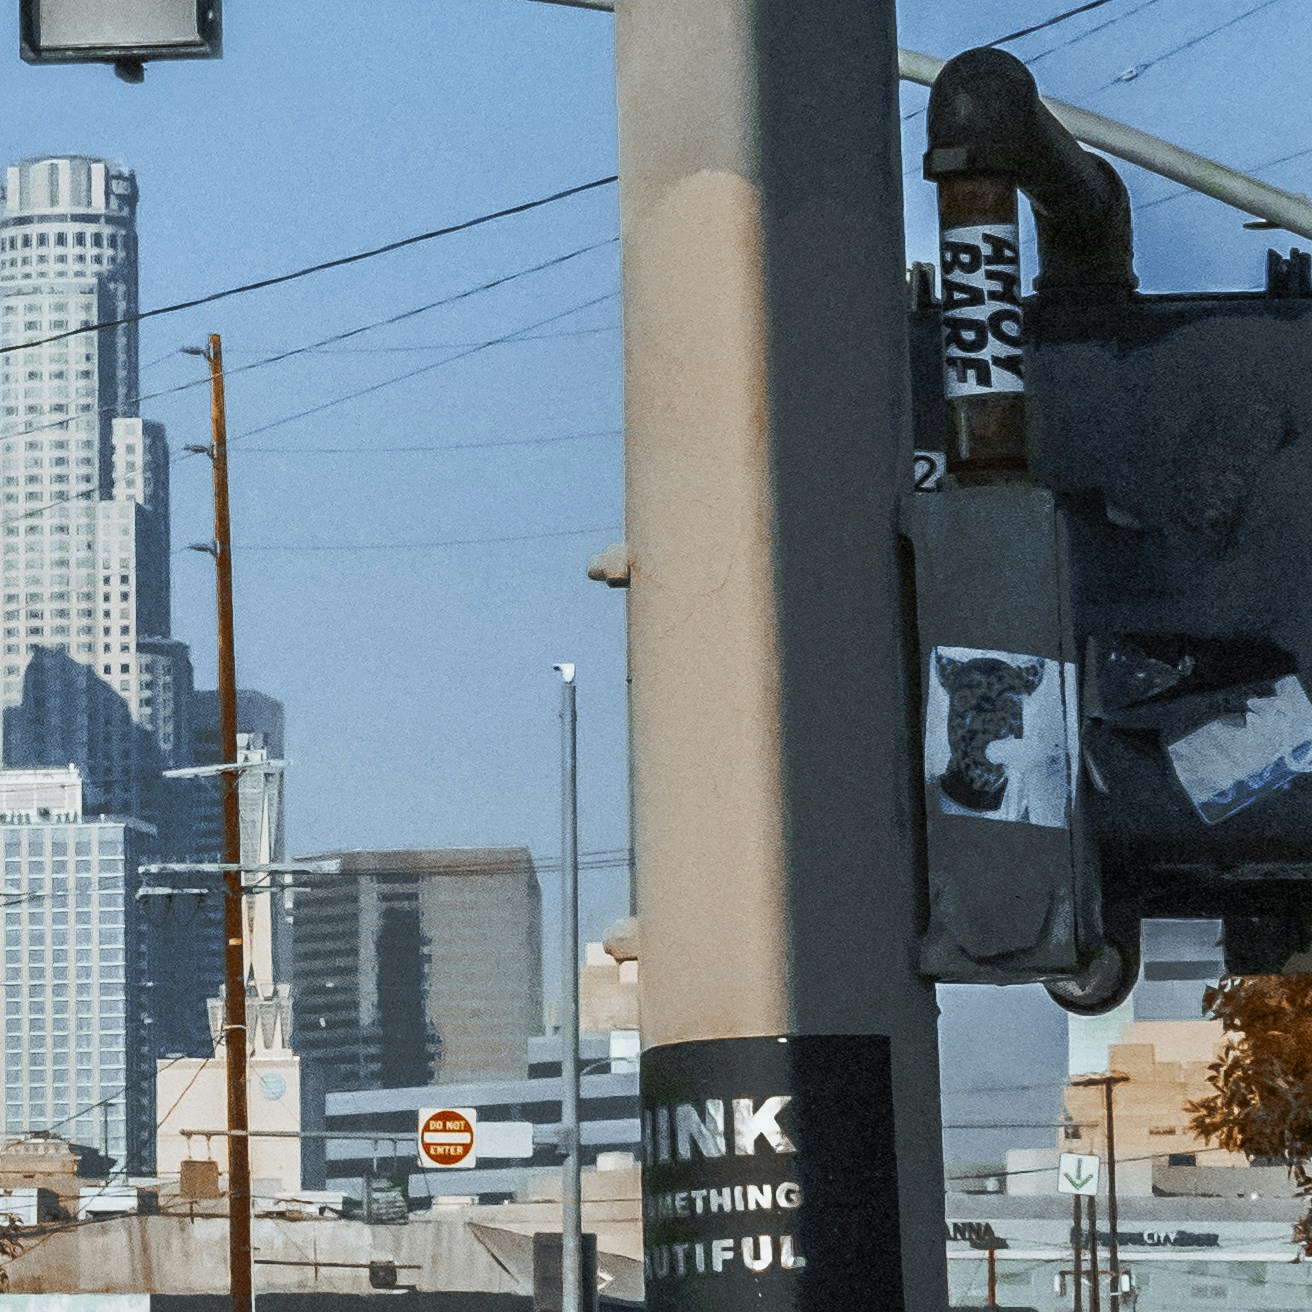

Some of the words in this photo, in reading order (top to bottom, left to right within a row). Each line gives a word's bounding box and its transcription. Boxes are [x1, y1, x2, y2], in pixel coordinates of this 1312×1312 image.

[942, 240, 993, 388] BARF
[429, 1120, 443, 1131] DO
[446, 1120, 465, 1131] NOT
[644, 1095, 798, 1165] INK
[429, 1145, 464, 1156] ENTER
